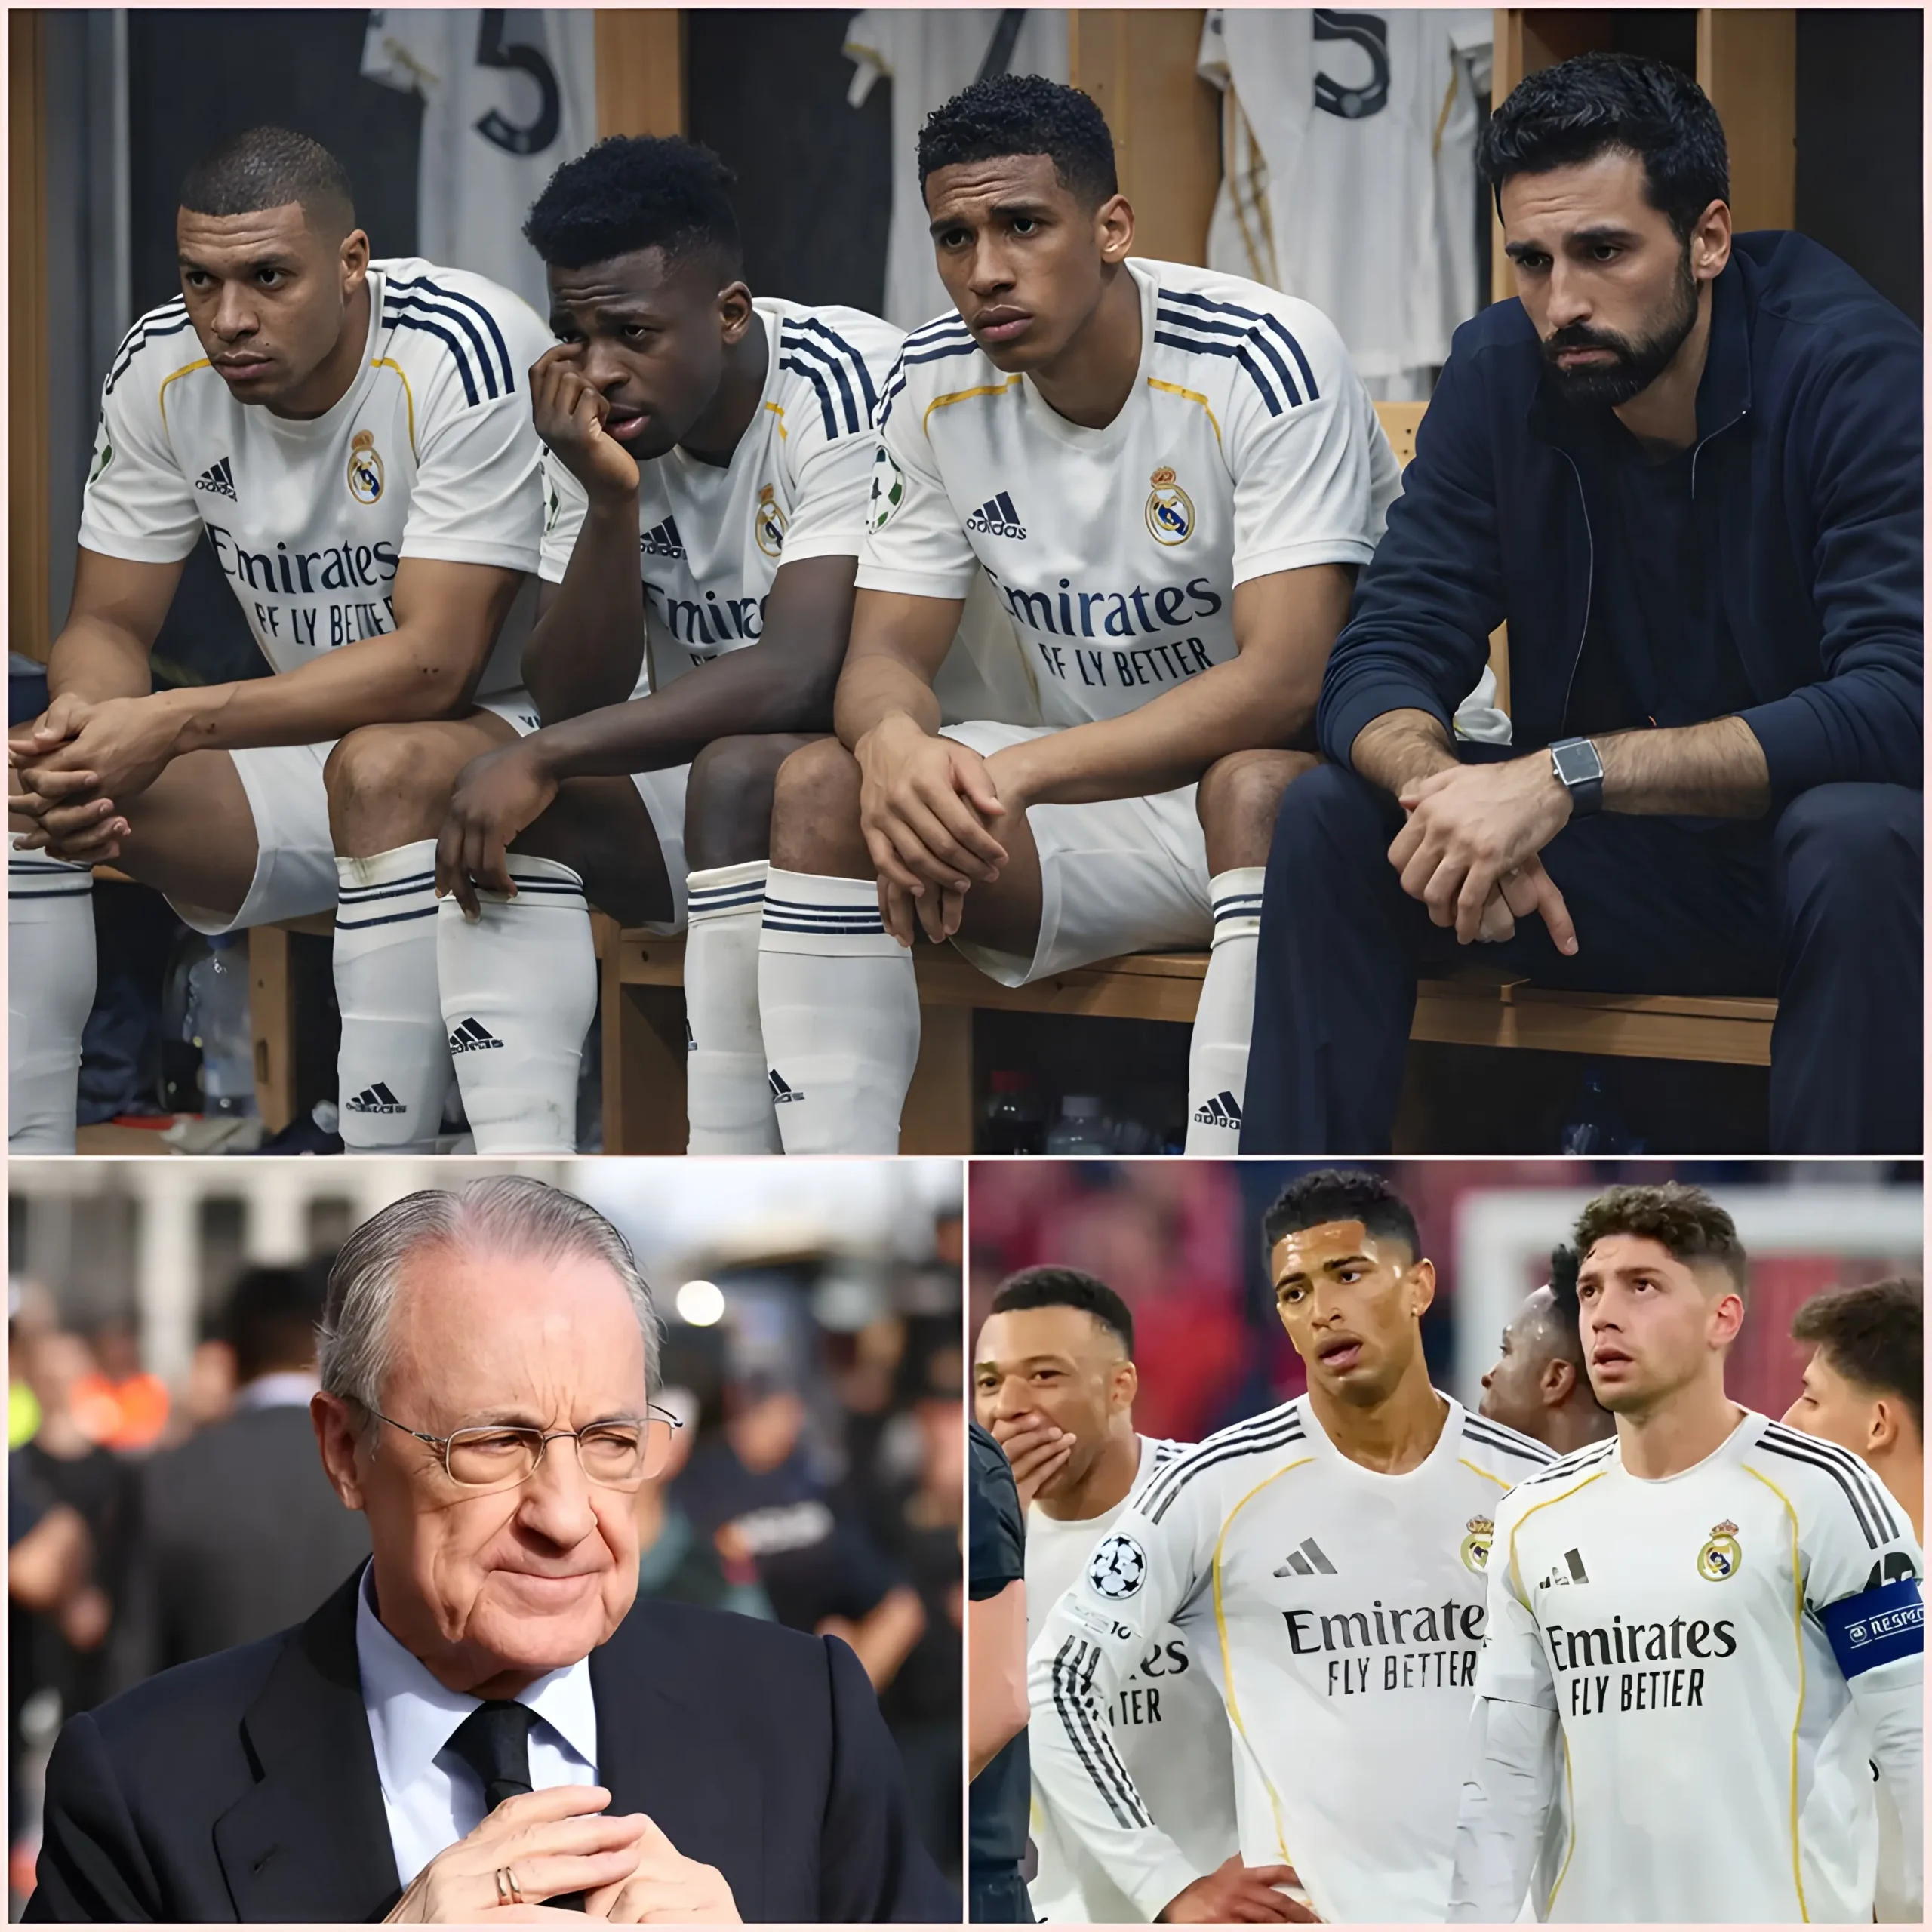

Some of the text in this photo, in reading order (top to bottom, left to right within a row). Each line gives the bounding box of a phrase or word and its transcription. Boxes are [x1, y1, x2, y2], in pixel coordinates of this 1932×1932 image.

[475, 9, 560, 155] 5
[205, 522, 400, 595] Emirates
[1113, 637, 1214, 687] BETTER
[1194, 1112, 1241, 1130] adida
[1282, 1598, 1485, 1654] Emirate
[1546, 1615, 1737, 1672] Emirates
[1328, 1651, 1477, 1697] FLY BETTER
[1571, 1669, 1704, 1717] FLY BETTER
[1109, 1687, 1161, 1727] TER
